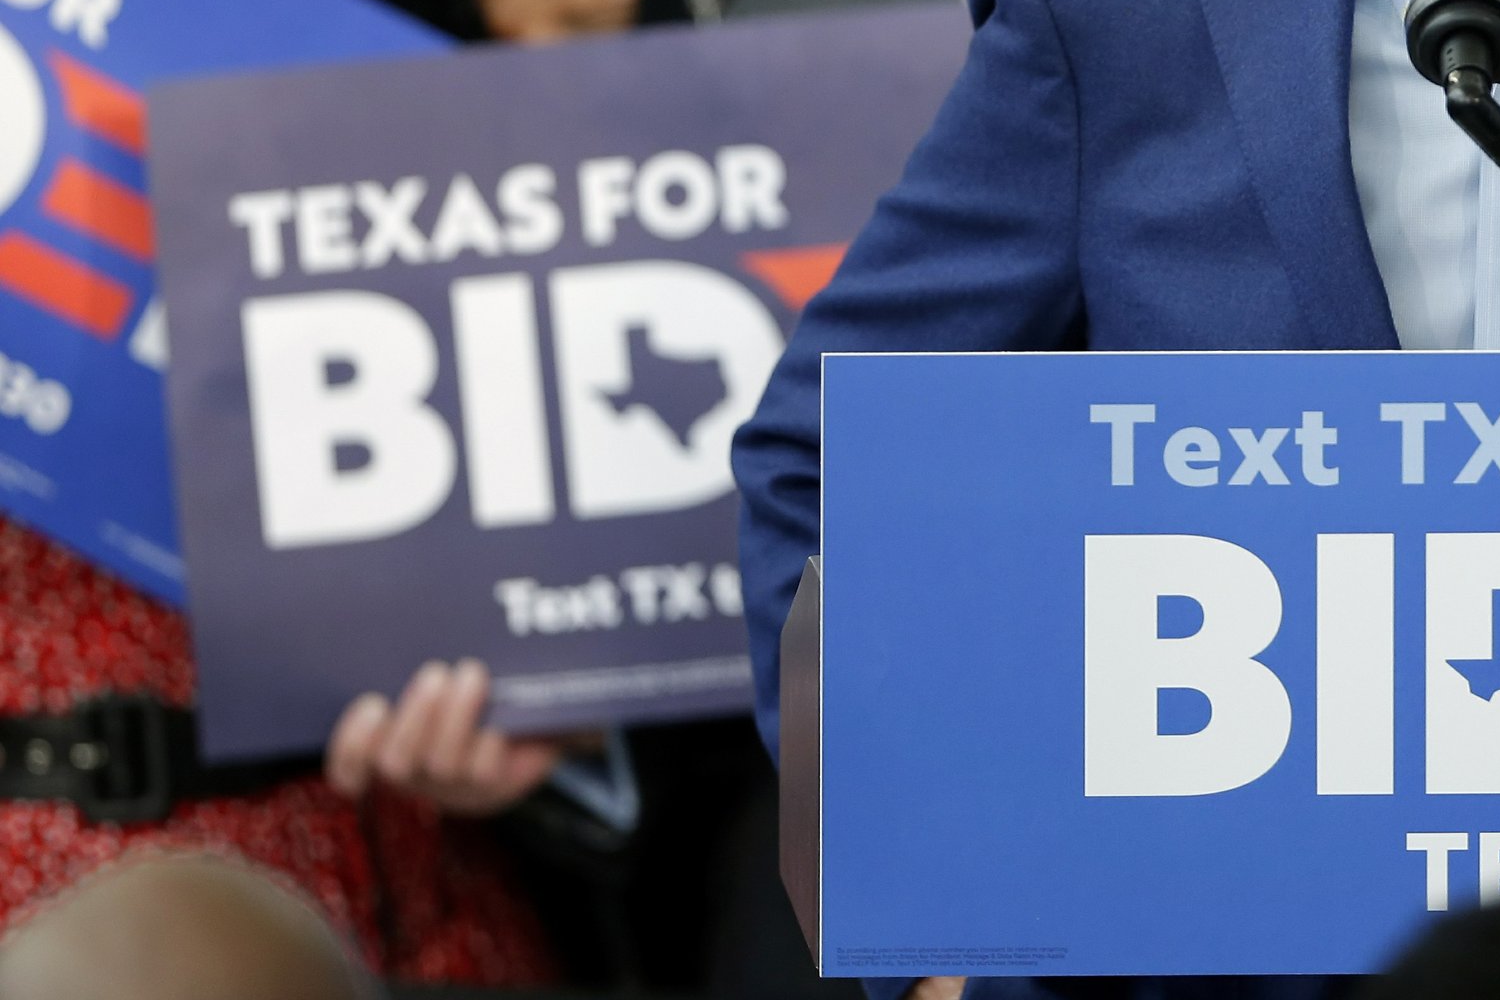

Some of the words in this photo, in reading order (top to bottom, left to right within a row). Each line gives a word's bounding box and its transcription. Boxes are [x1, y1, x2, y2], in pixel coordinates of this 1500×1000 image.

[230, 163, 564, 278] TEXAS
[578, 144, 788, 246] FOR
[241, 244, 850, 549] BID
[1090, 404, 1339, 486] Text
